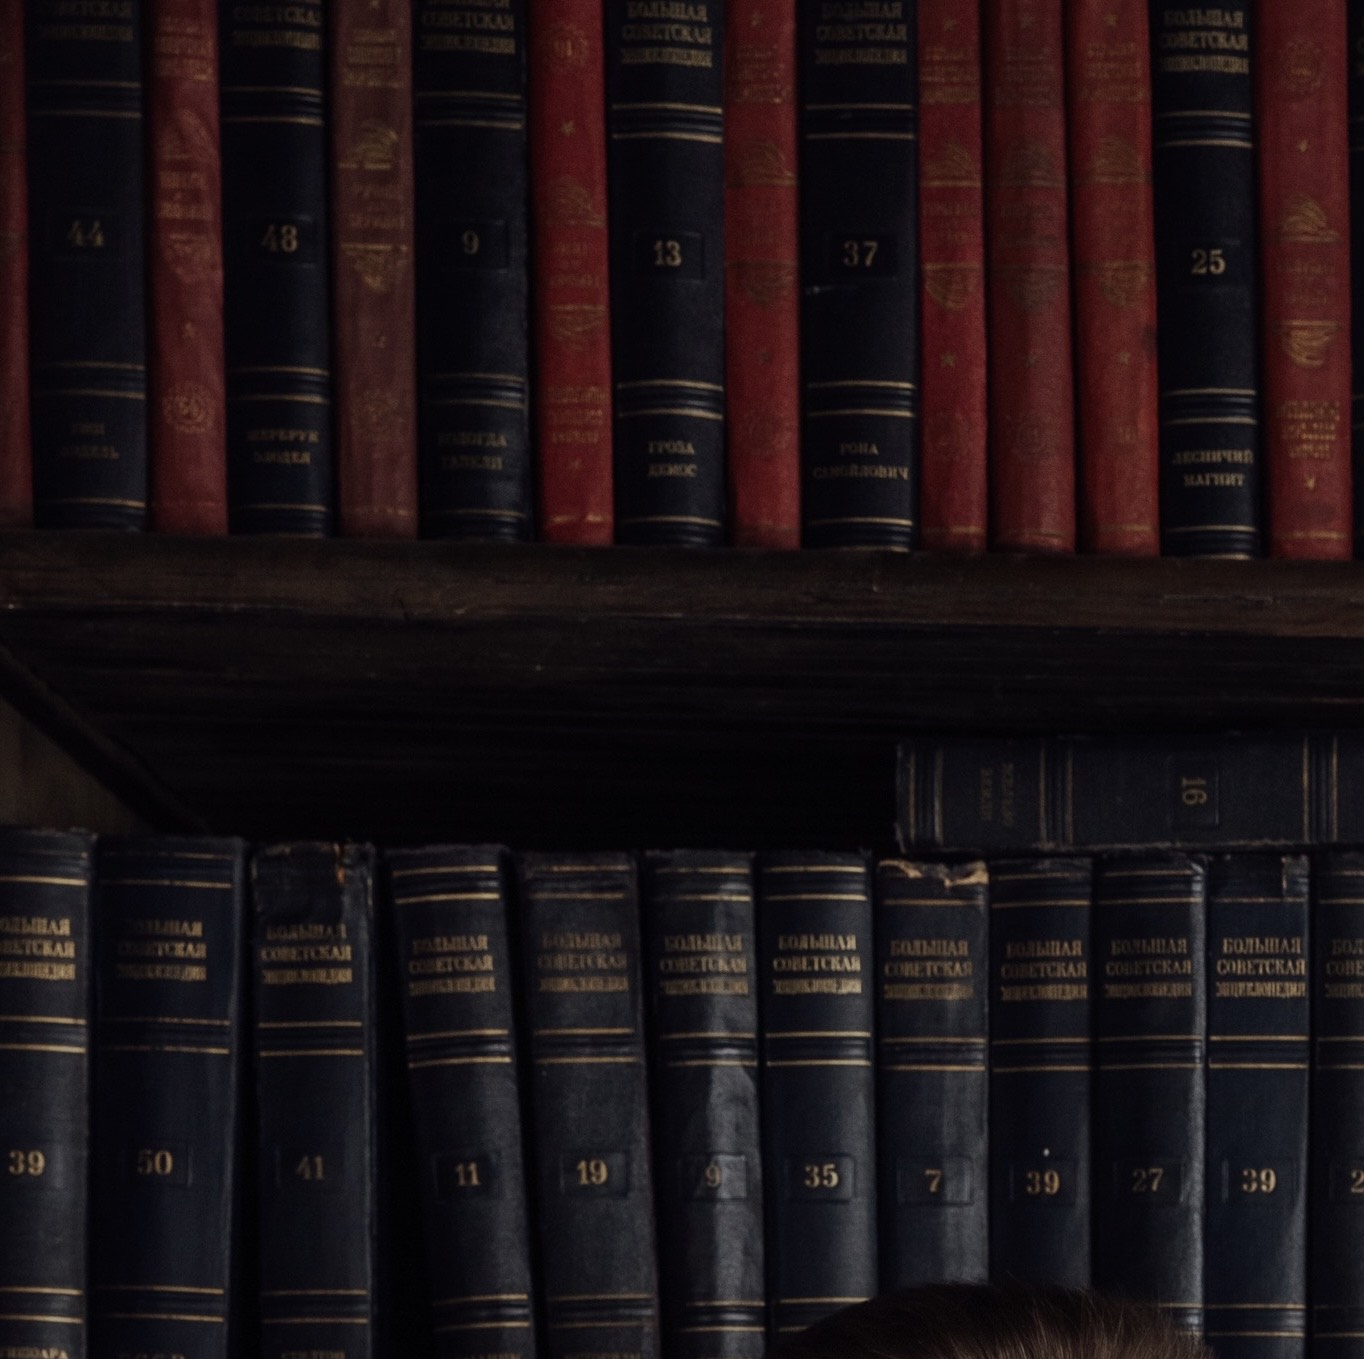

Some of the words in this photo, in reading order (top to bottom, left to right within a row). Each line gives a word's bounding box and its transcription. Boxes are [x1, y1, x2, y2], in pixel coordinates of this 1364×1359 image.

[262, 224, 300, 253] 48
[655, 240, 683, 268] 13
[841, 239, 879, 269] 37
[1191, 248, 1227, 275] 25
[1180, 777, 1210, 806] 16
[778, 934, 859, 950] БОЛЬШАЯ
[889, 939, 971, 956] БОЛЬШАЯ
[1007, 940, 1084, 956] БОЛЬШАЯ
[1221, 937, 1303, 954] БОЛЬШАЯ
[773, 957, 862, 971] СОВЕТСКАЯ
[885, 962, 974, 976] СОВЕТСКАЯ
[999, 963, 1088, 977] СОВЕТСКАЯ
[1216, 959, 1307, 975] СОВЕТСКАЯ
[9, 1150, 47, 1177] 39
[139, 1150, 176, 1175] 50
[297, 1155, 326, 1180] 41
[456, 1162, 480, 1186] 11
[577, 1160, 609, 1185] 19
[704, 1164, 724, 1186] 9
[804, 1163, 841, 1188] 35
[923, 1168, 943, 1194] 7
[1025, 1171, 1062, 1195] 39
[1132, 1167, 1165, 1192] 27
[1241, 1168, 1278, 1193] 39
